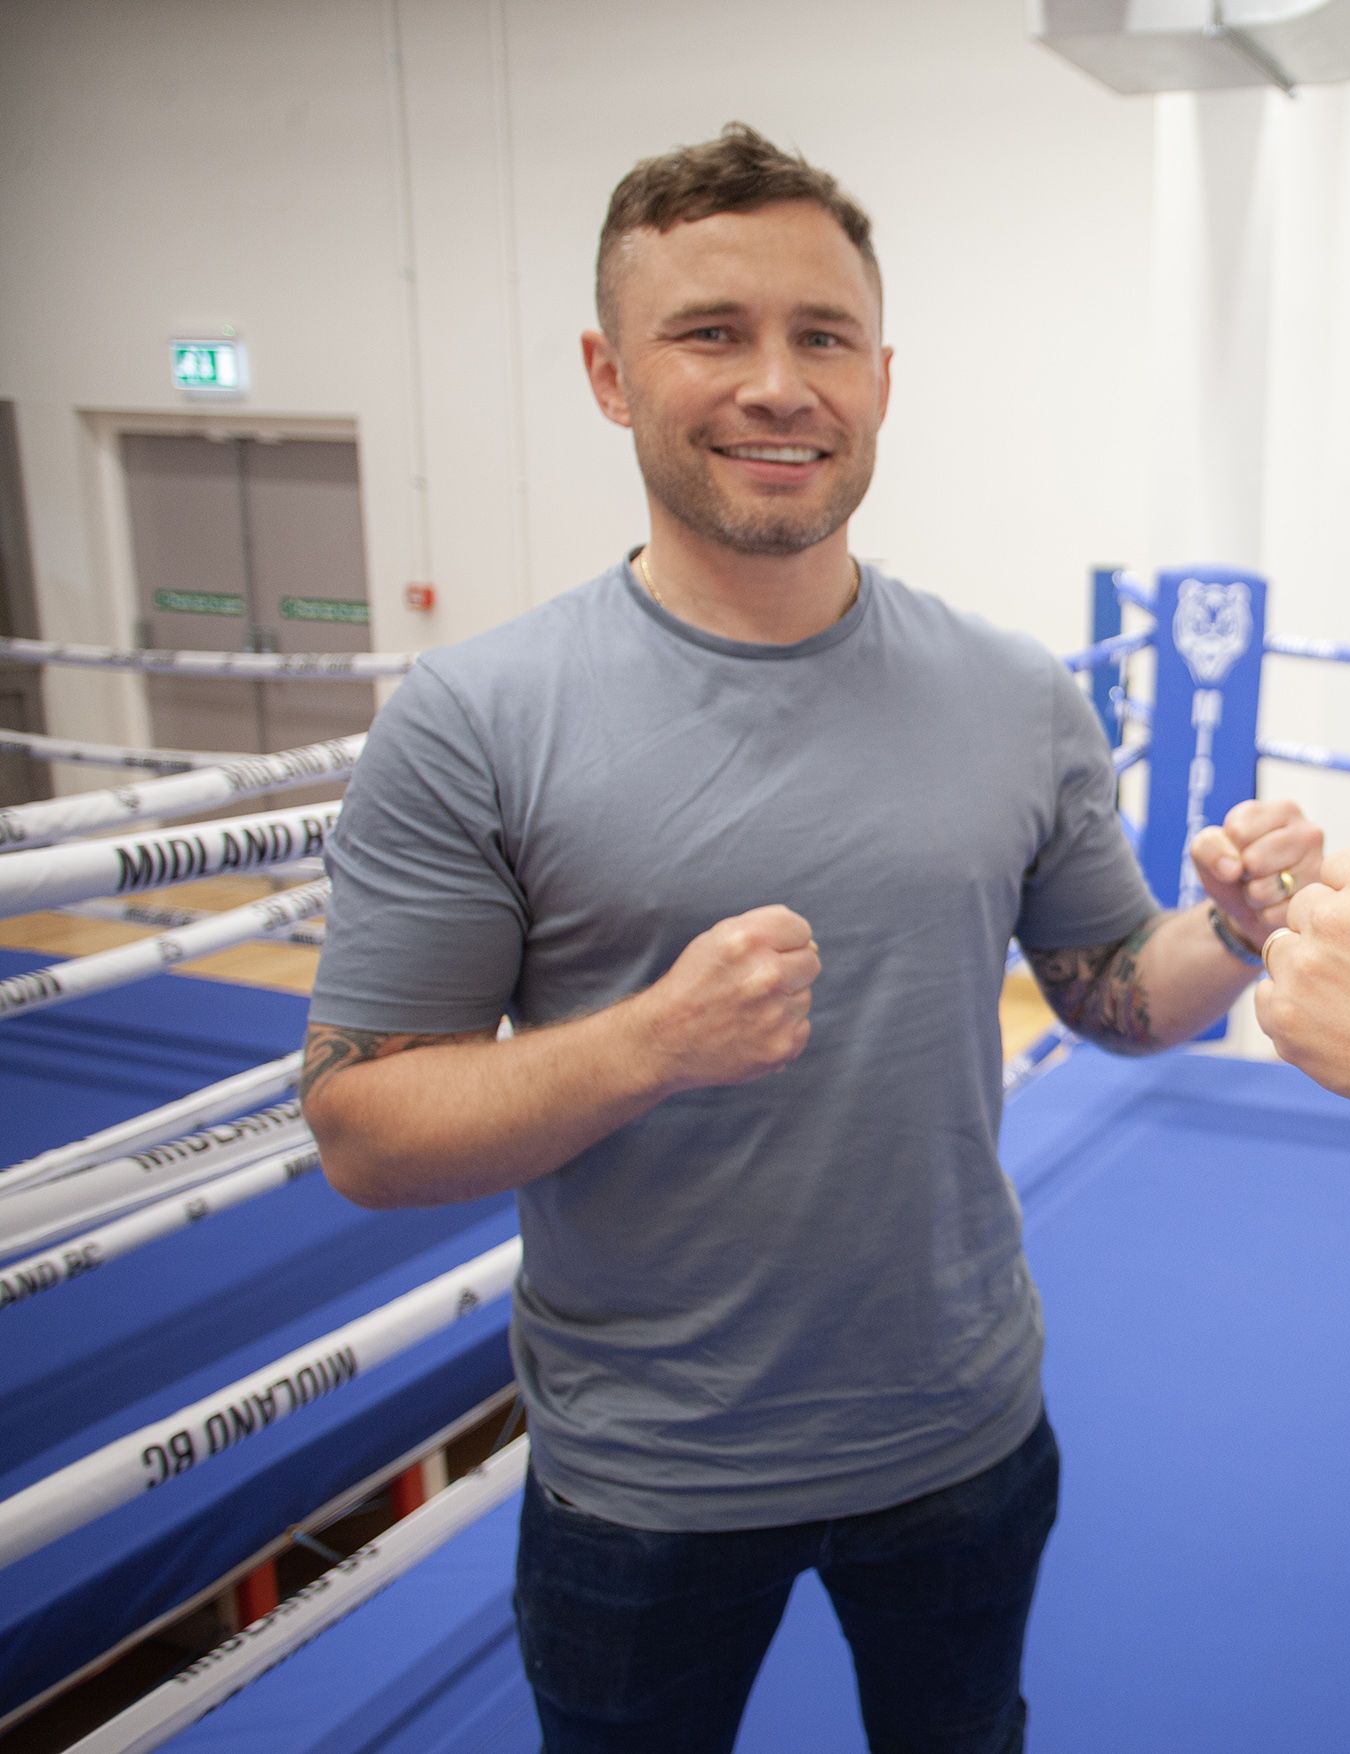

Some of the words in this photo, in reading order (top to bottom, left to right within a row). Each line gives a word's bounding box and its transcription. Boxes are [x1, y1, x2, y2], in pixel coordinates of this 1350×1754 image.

[114, 824, 294, 893] MIDLAND
[205, 1345, 359, 1456] MIDLAND
[141, 1430, 196, 1490] BC
